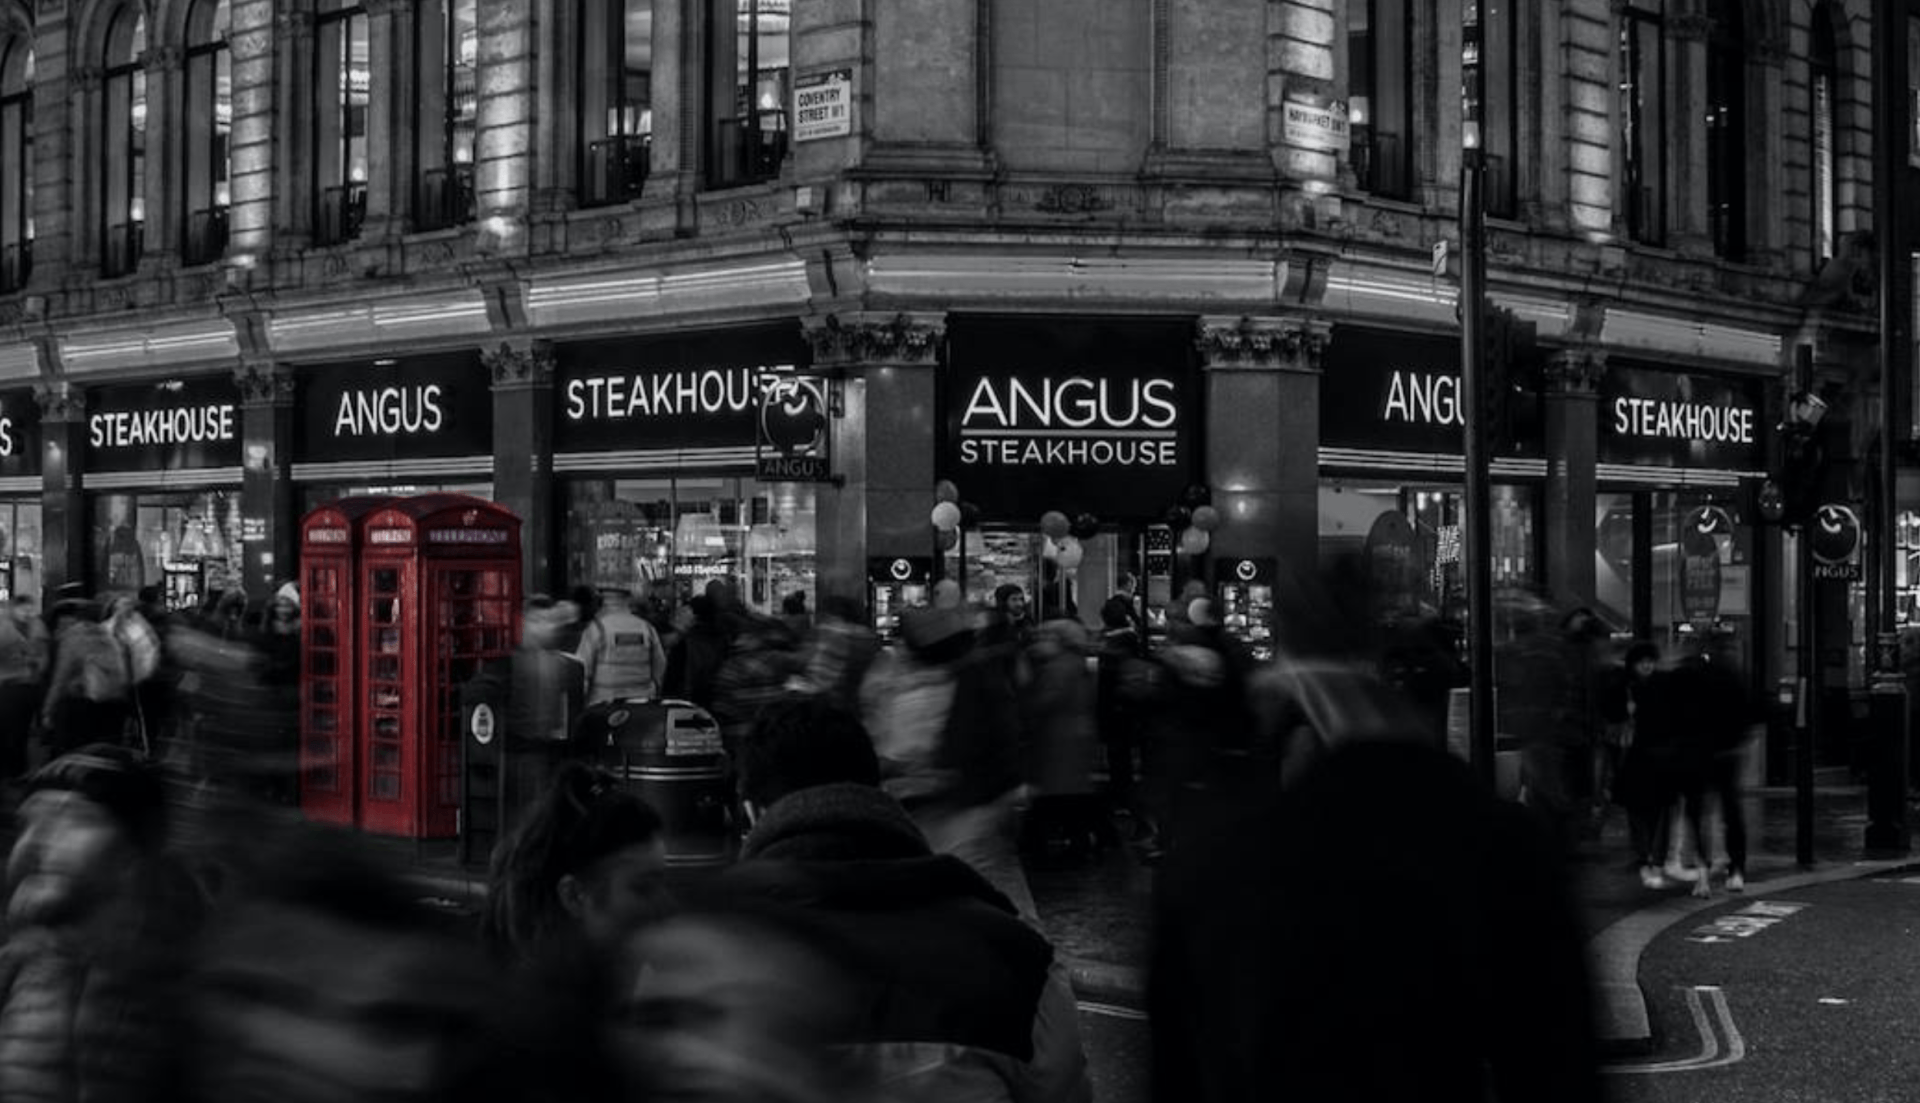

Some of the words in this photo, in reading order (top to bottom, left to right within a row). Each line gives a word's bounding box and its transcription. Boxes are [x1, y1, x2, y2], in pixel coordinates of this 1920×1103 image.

[799, 89, 841, 107] COVENTRY
[799, 105, 829, 124] STREET
[832, 103, 845, 118] W1
[334, 384, 442, 436] ANGUS
[962, 376, 1177, 428] ANGUS
[1385, 370, 1465, 426] ANGU
[90, 404, 234, 447] STEAKHOUSE
[1615, 396, 1753, 447] STEAKHOUSE
[764, 458, 826, 478] ANGUS
[960, 439, 1176, 466] STEAKHOUSE
[1814, 563, 1860, 578] NGUS
